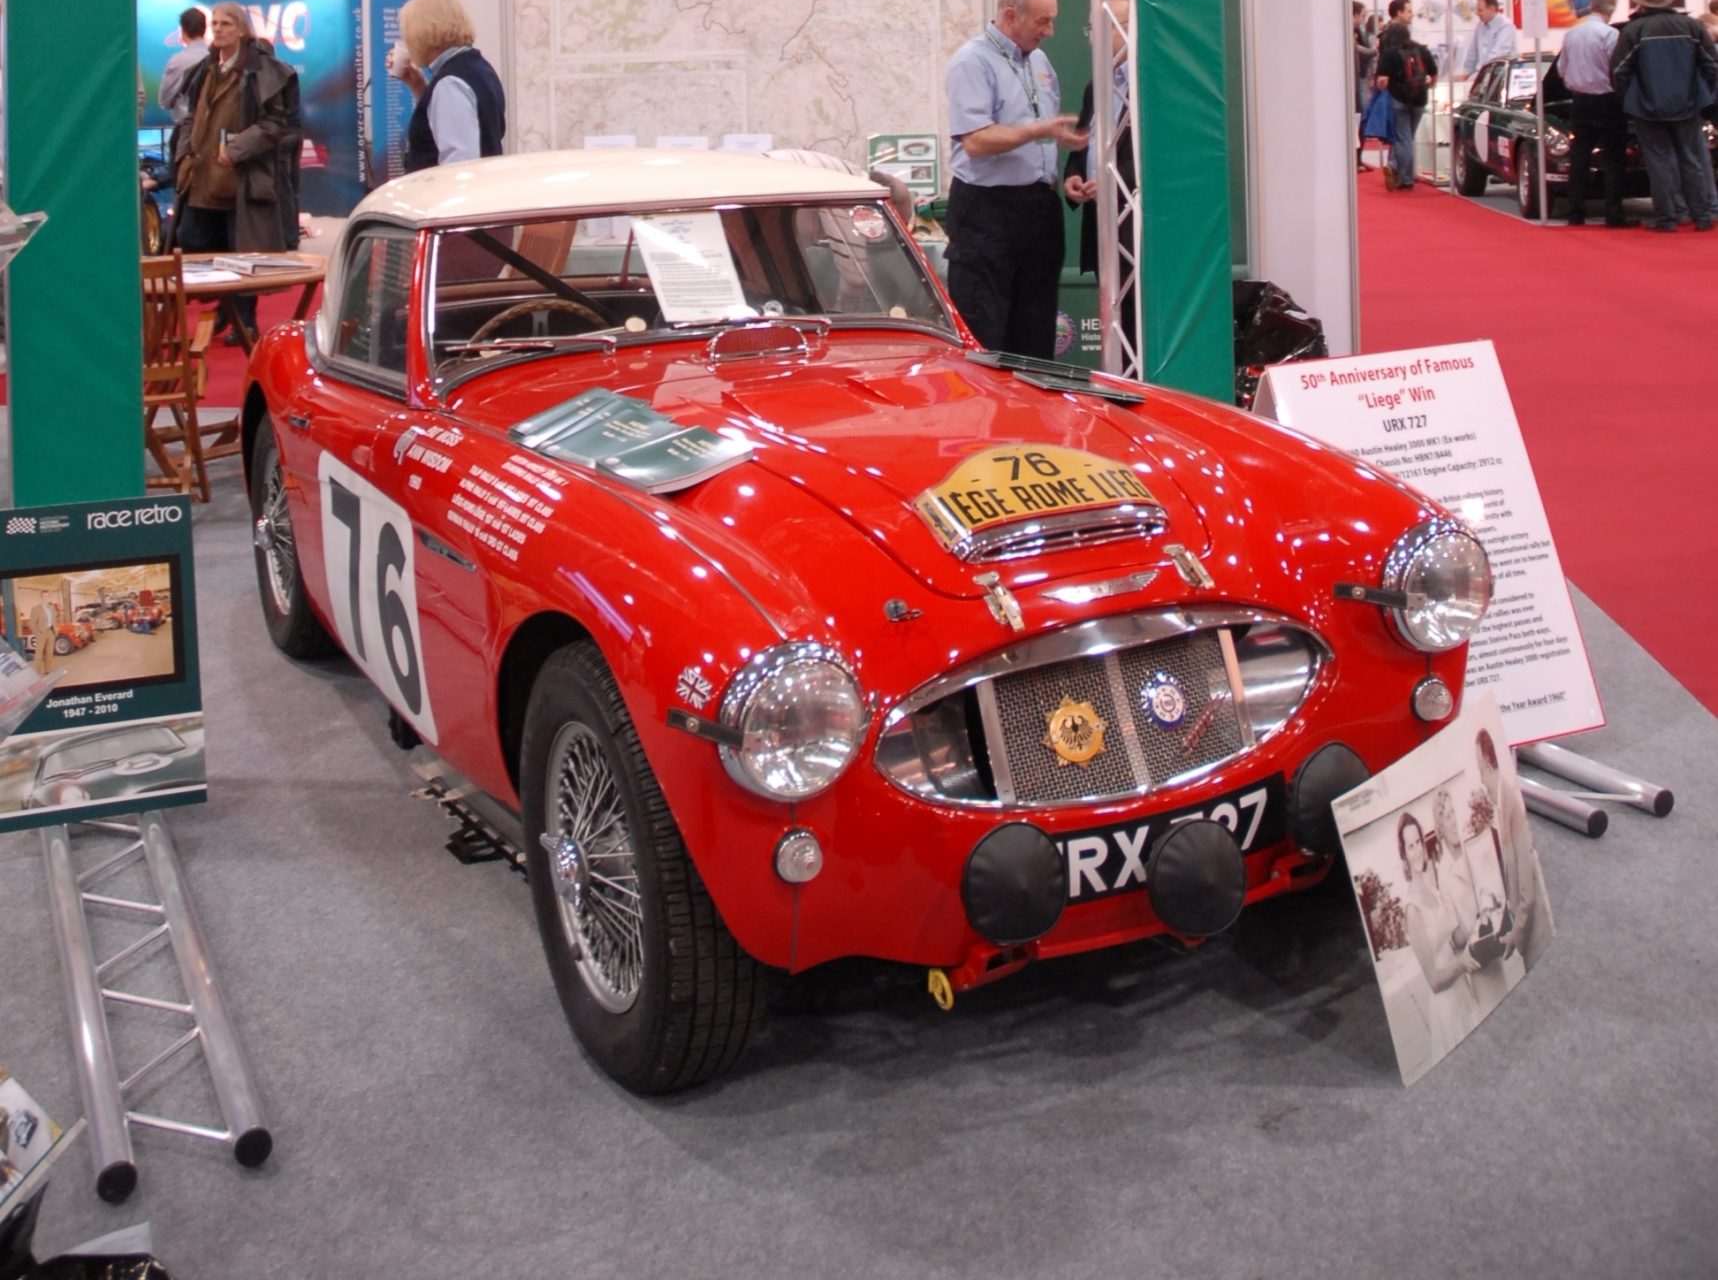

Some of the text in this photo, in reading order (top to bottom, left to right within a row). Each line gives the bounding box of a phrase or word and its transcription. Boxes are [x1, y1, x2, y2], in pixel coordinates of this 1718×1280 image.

[1081, 319, 1101, 331] HE
[1081, 333, 1102, 341] Histo
[1301, 356, 1475, 390] 50th Anniversary of Famous
[1408, 386, 1436, 403] Win
[1383, 415, 1427, 433] URX 727
[1361, 445, 1383, 455] Austin
[1384, 441, 1407, 453] Healey
[1408, 438, 1425, 448] 3000
[993, 452, 1061, 481] 76
[1376, 458, 1400, 468] Chassis
[1423, 465, 1446, 477] Engine
[1478, 458, 1495, 467] 2912
[1010, 469, 1153, 511] ROME LIEG
[87, 504, 183, 530] race retro
[329, 475, 422, 717] 76
[46, 689, 134, 709] Jonathan Everard
[63, 703, 118, 718] 1947 2010
[1056, 825, 1149, 898] RX
